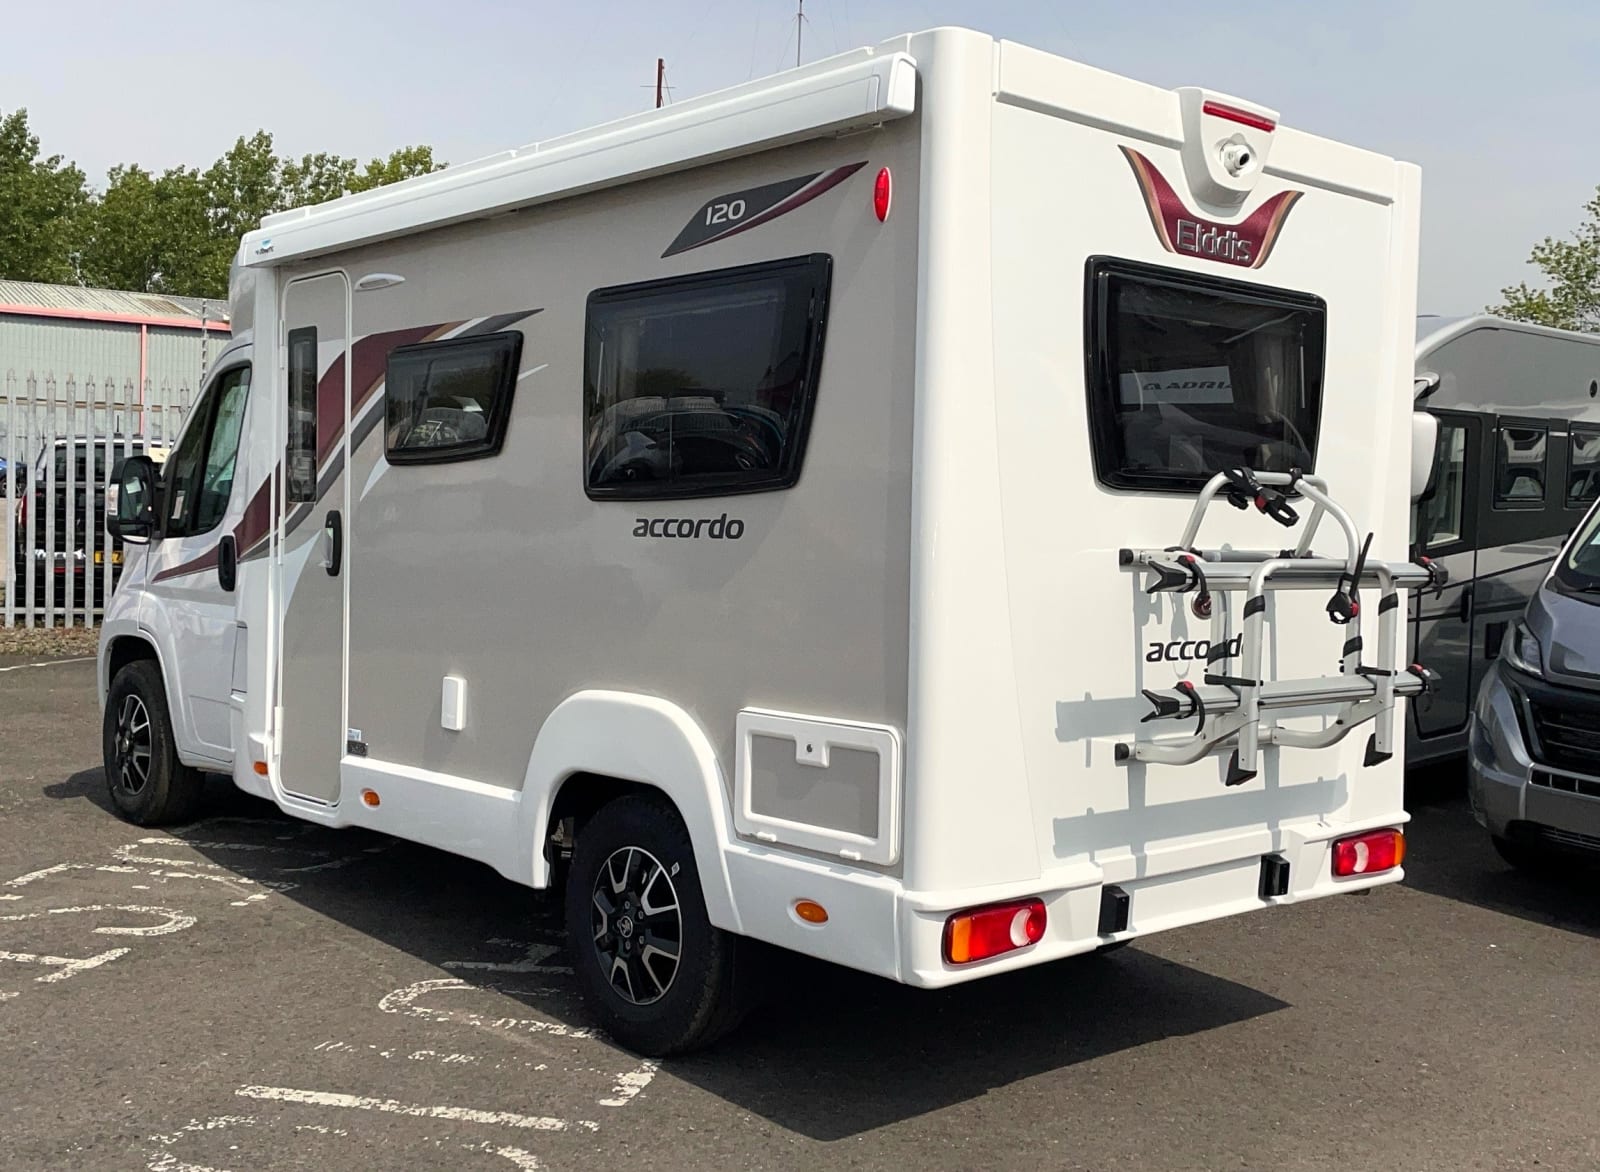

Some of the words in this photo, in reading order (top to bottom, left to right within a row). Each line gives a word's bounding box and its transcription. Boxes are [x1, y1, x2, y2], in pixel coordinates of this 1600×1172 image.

[705, 199, 746, 226] 120
[1176, 218, 1253, 262] Elddis
[632, 513, 745, 540] accordo
[1145, 632, 1245, 662] accod
